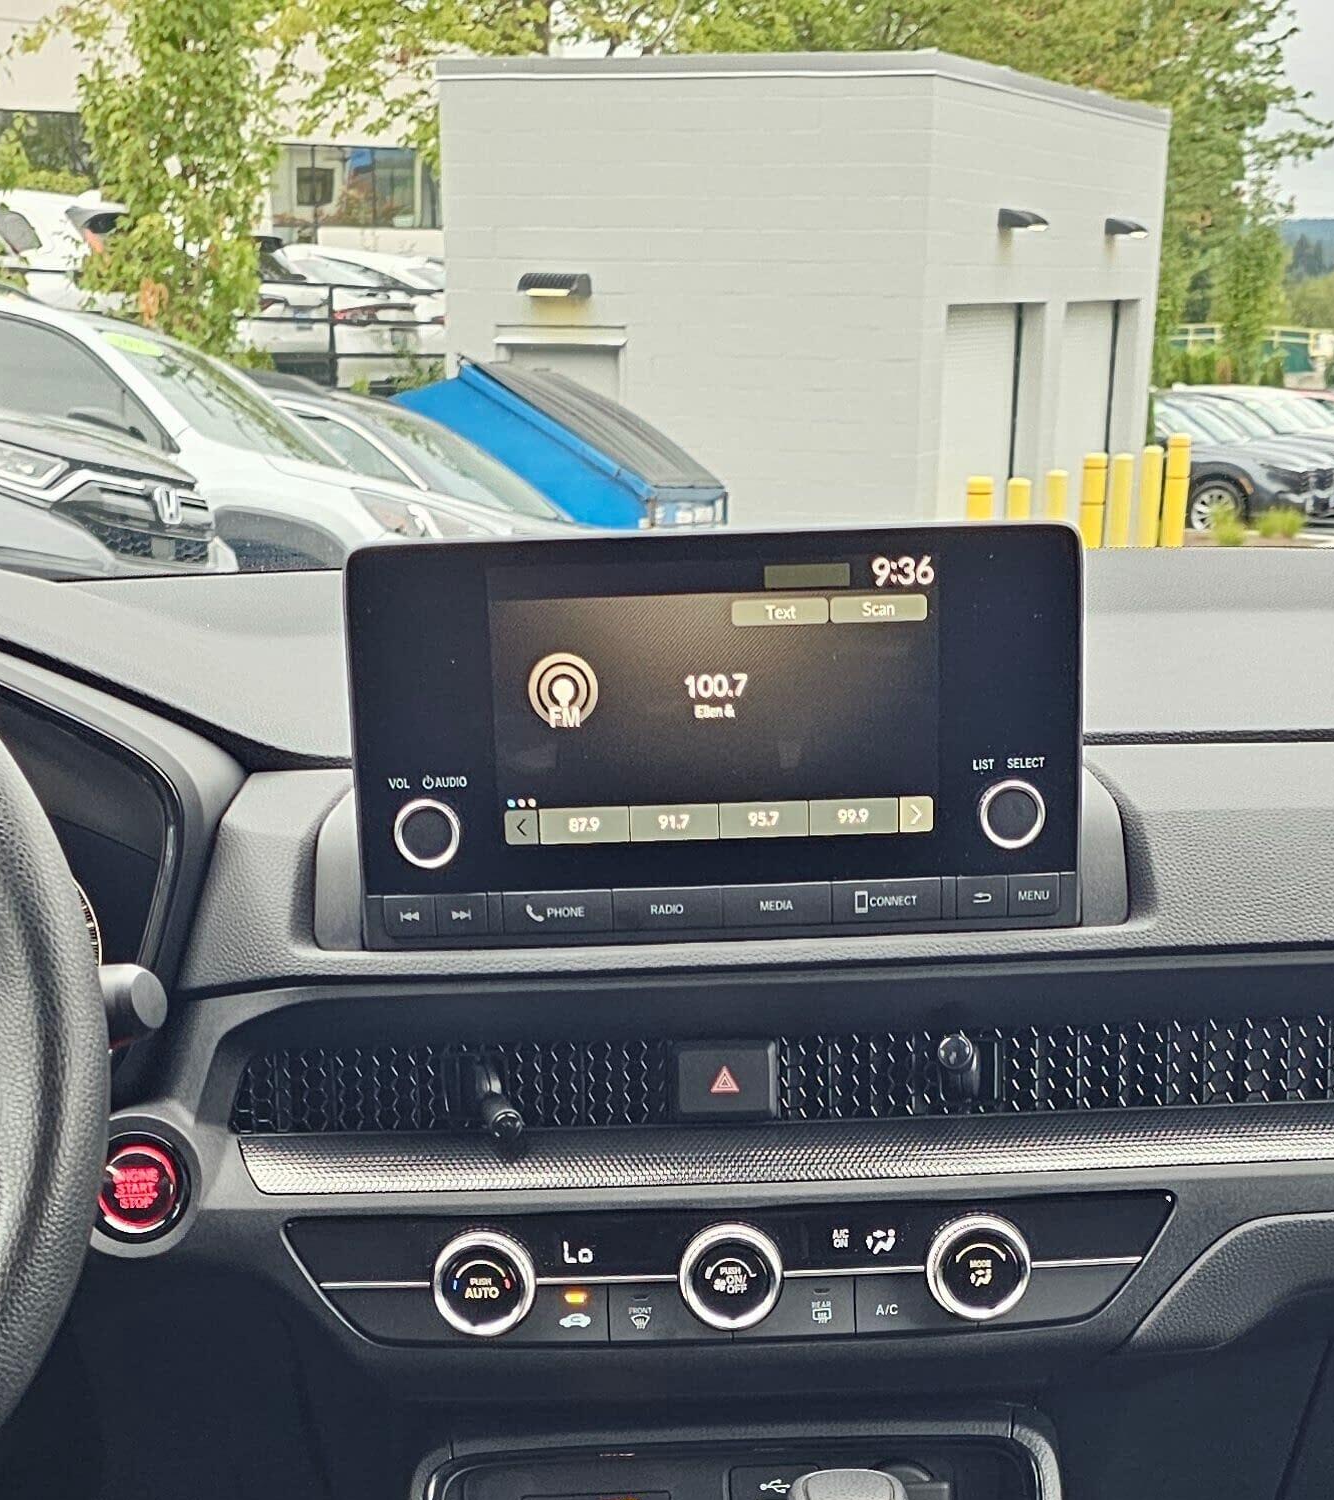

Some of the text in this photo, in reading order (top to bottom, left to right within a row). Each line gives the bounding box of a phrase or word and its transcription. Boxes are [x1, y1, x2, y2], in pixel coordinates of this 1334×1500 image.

[871, 556, 935, 588] 9:36
[766, 604, 797, 620] Text
[862, 601, 895, 617] Scan
[684, 673, 748, 699] 100.7
[549, 706, 581, 729] FM
[973, 758, 995, 771] LIST
[1007, 757, 1045, 769] SELECT
[388, 778, 410, 790] VOL
[435, 776, 467, 789] AUDIO
[658, 814, 690, 830] 91.7
[747, 811, 779, 828] 95.7
[838, 808, 869, 824] 99.9
[568, 817, 600, 833] 87.9
[870, 895, 917, 908] CONNECT
[1018, 891, 1050, 901] MENU
[546, 906, 585, 918] PHONE
[650, 904, 684, 915] RADIO
[760, 900, 794, 912] MEDIA
[115, 1182, 156, 1194] START
[119, 1197, 154, 1209] STOP
[832, 1229, 850, 1239] A/C
[833, 1239, 849, 1249] ON
[969, 1259, 992, 1268] MODE
[719, 1266, 742, 1276] PUSH
[469, 1277, 493, 1286] PUSH
[464, 1287, 500, 1299] AUTO
[726, 1285, 748, 1294] OFF
[628, 1306, 652, 1315] FRONT
[811, 1301, 832, 1309] REAR
[875, 1303, 899, 1316] A/C
